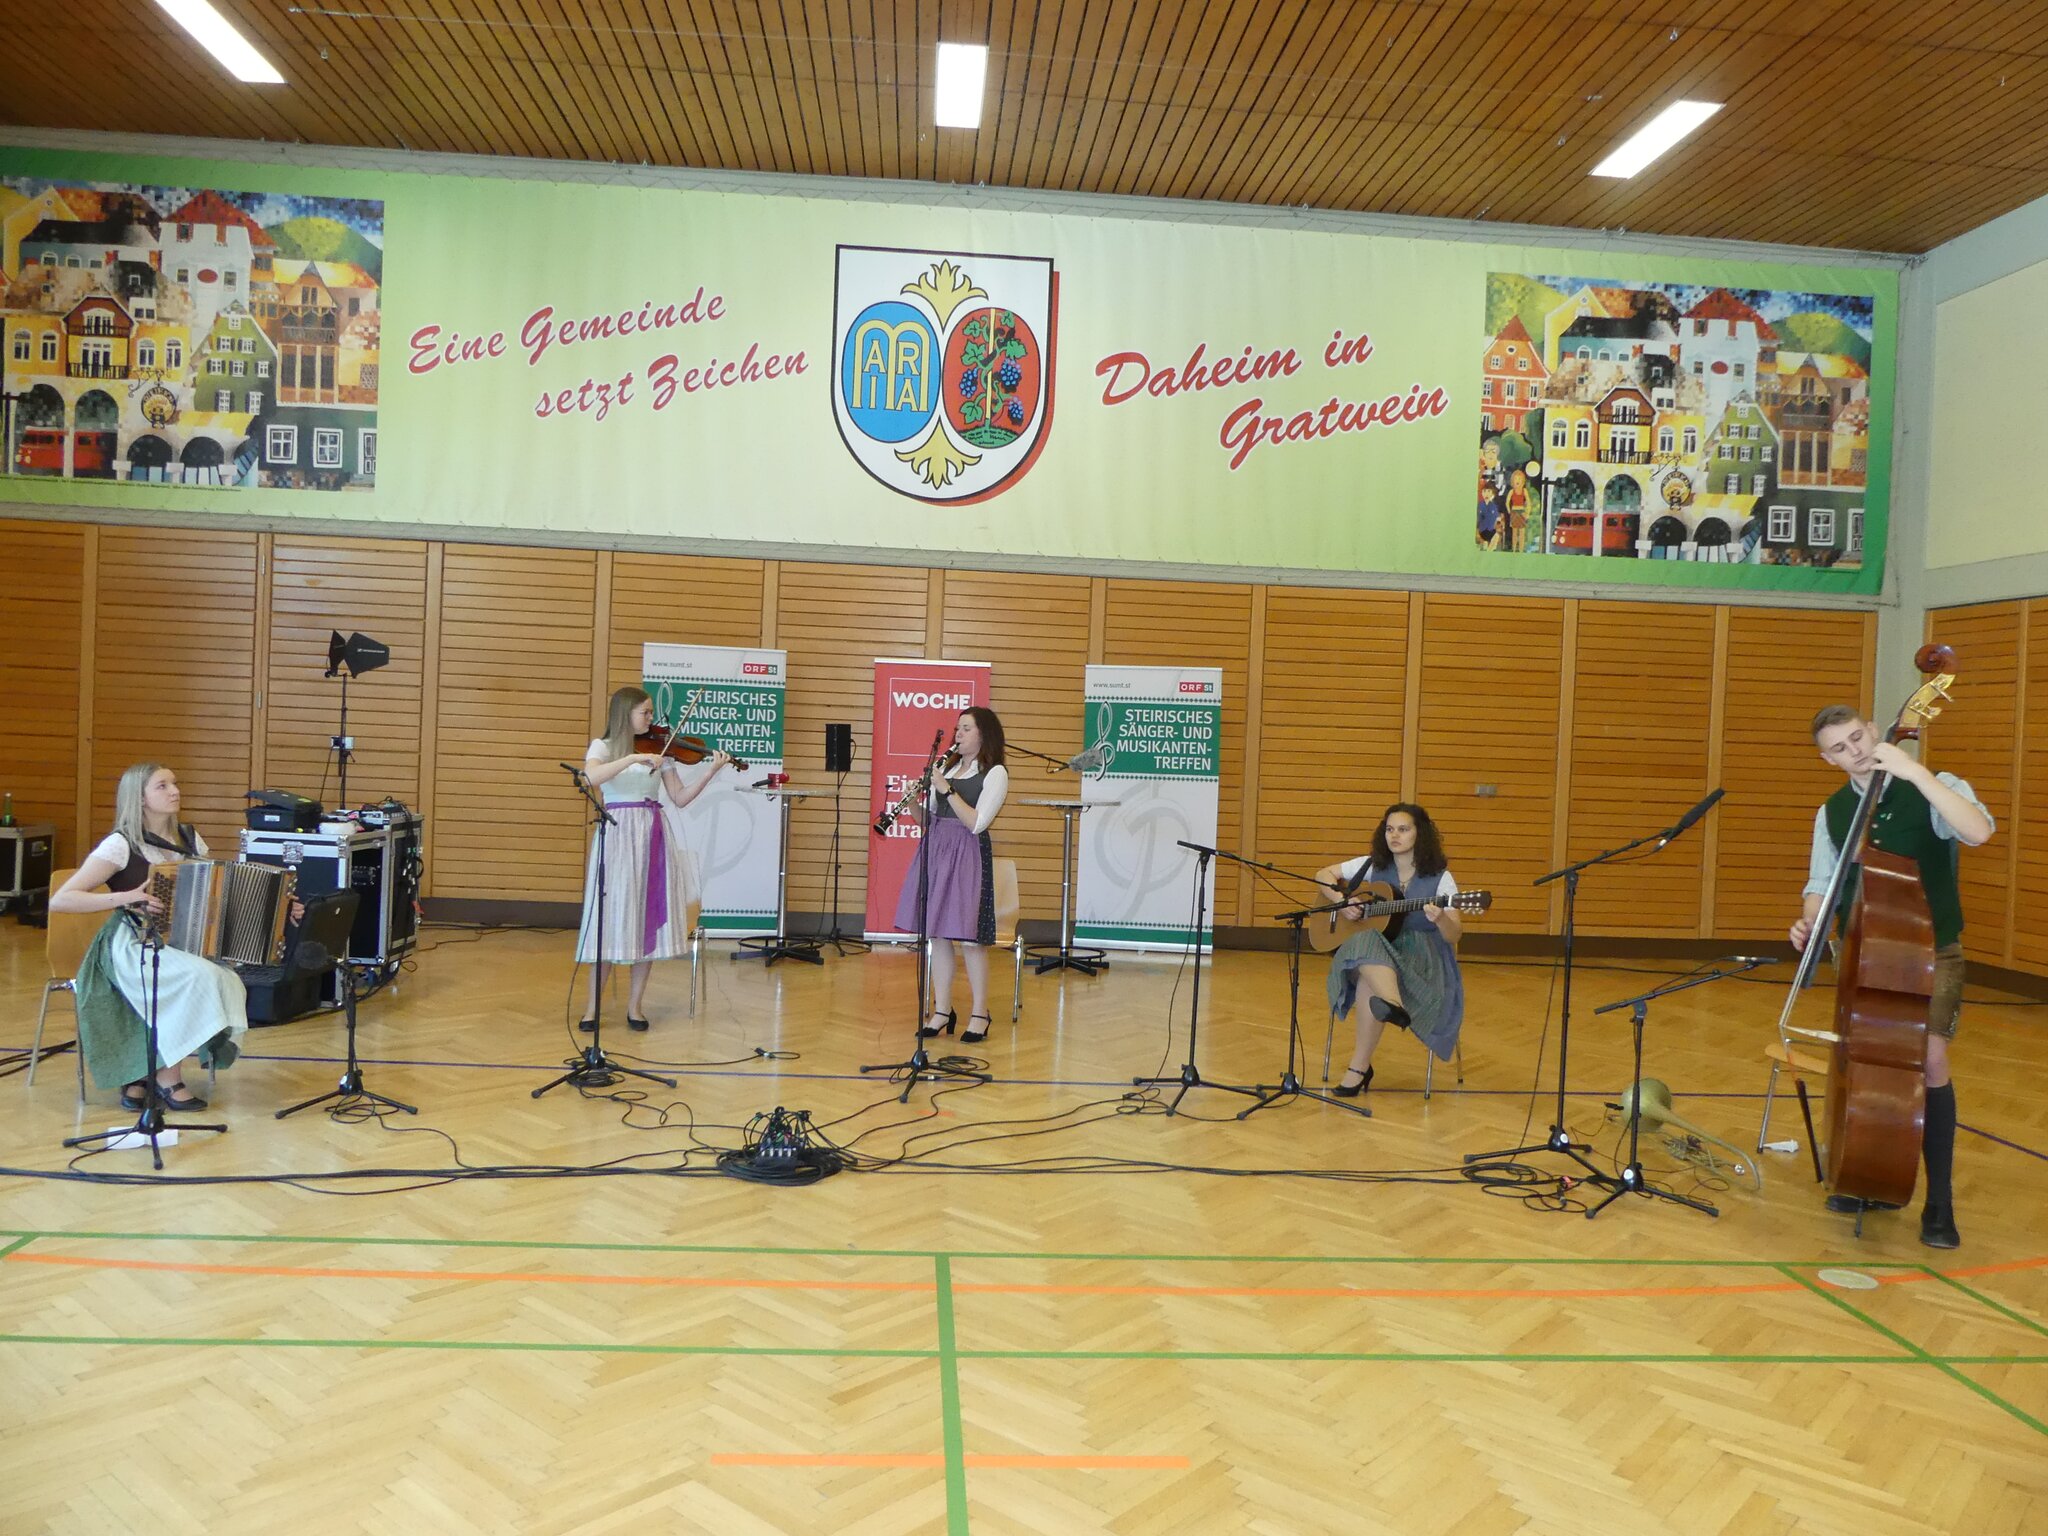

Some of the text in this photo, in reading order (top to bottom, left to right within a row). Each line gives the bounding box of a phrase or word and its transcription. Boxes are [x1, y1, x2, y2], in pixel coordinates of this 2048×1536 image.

[408, 286, 727, 375] Eine Gemeinde
[1095, 330, 1374, 406] Daheim in
[534, 342, 810, 422] setzt Zeichen
[1219, 384, 1449, 471] Gratwein
[744, 664, 767, 674] ORF
[1180, 683, 1202, 692] ORF
[686, 689, 777, 707] STEIRISCHES
[892, 691, 971, 710] WOCHE
[679, 703, 777, 722] SÄNGER- UND
[1125, 709, 1213, 724] STEIRISCHES
[677, 721, 776, 738] MUSIKANTEN-
[1118, 722, 1213, 740] SÄNGER- UND
[716, 738, 775, 754] TREFFEN
[1116, 740, 1212, 755] MUSIKANTEN-
[1154, 756, 1211, 771] TREFFEN
